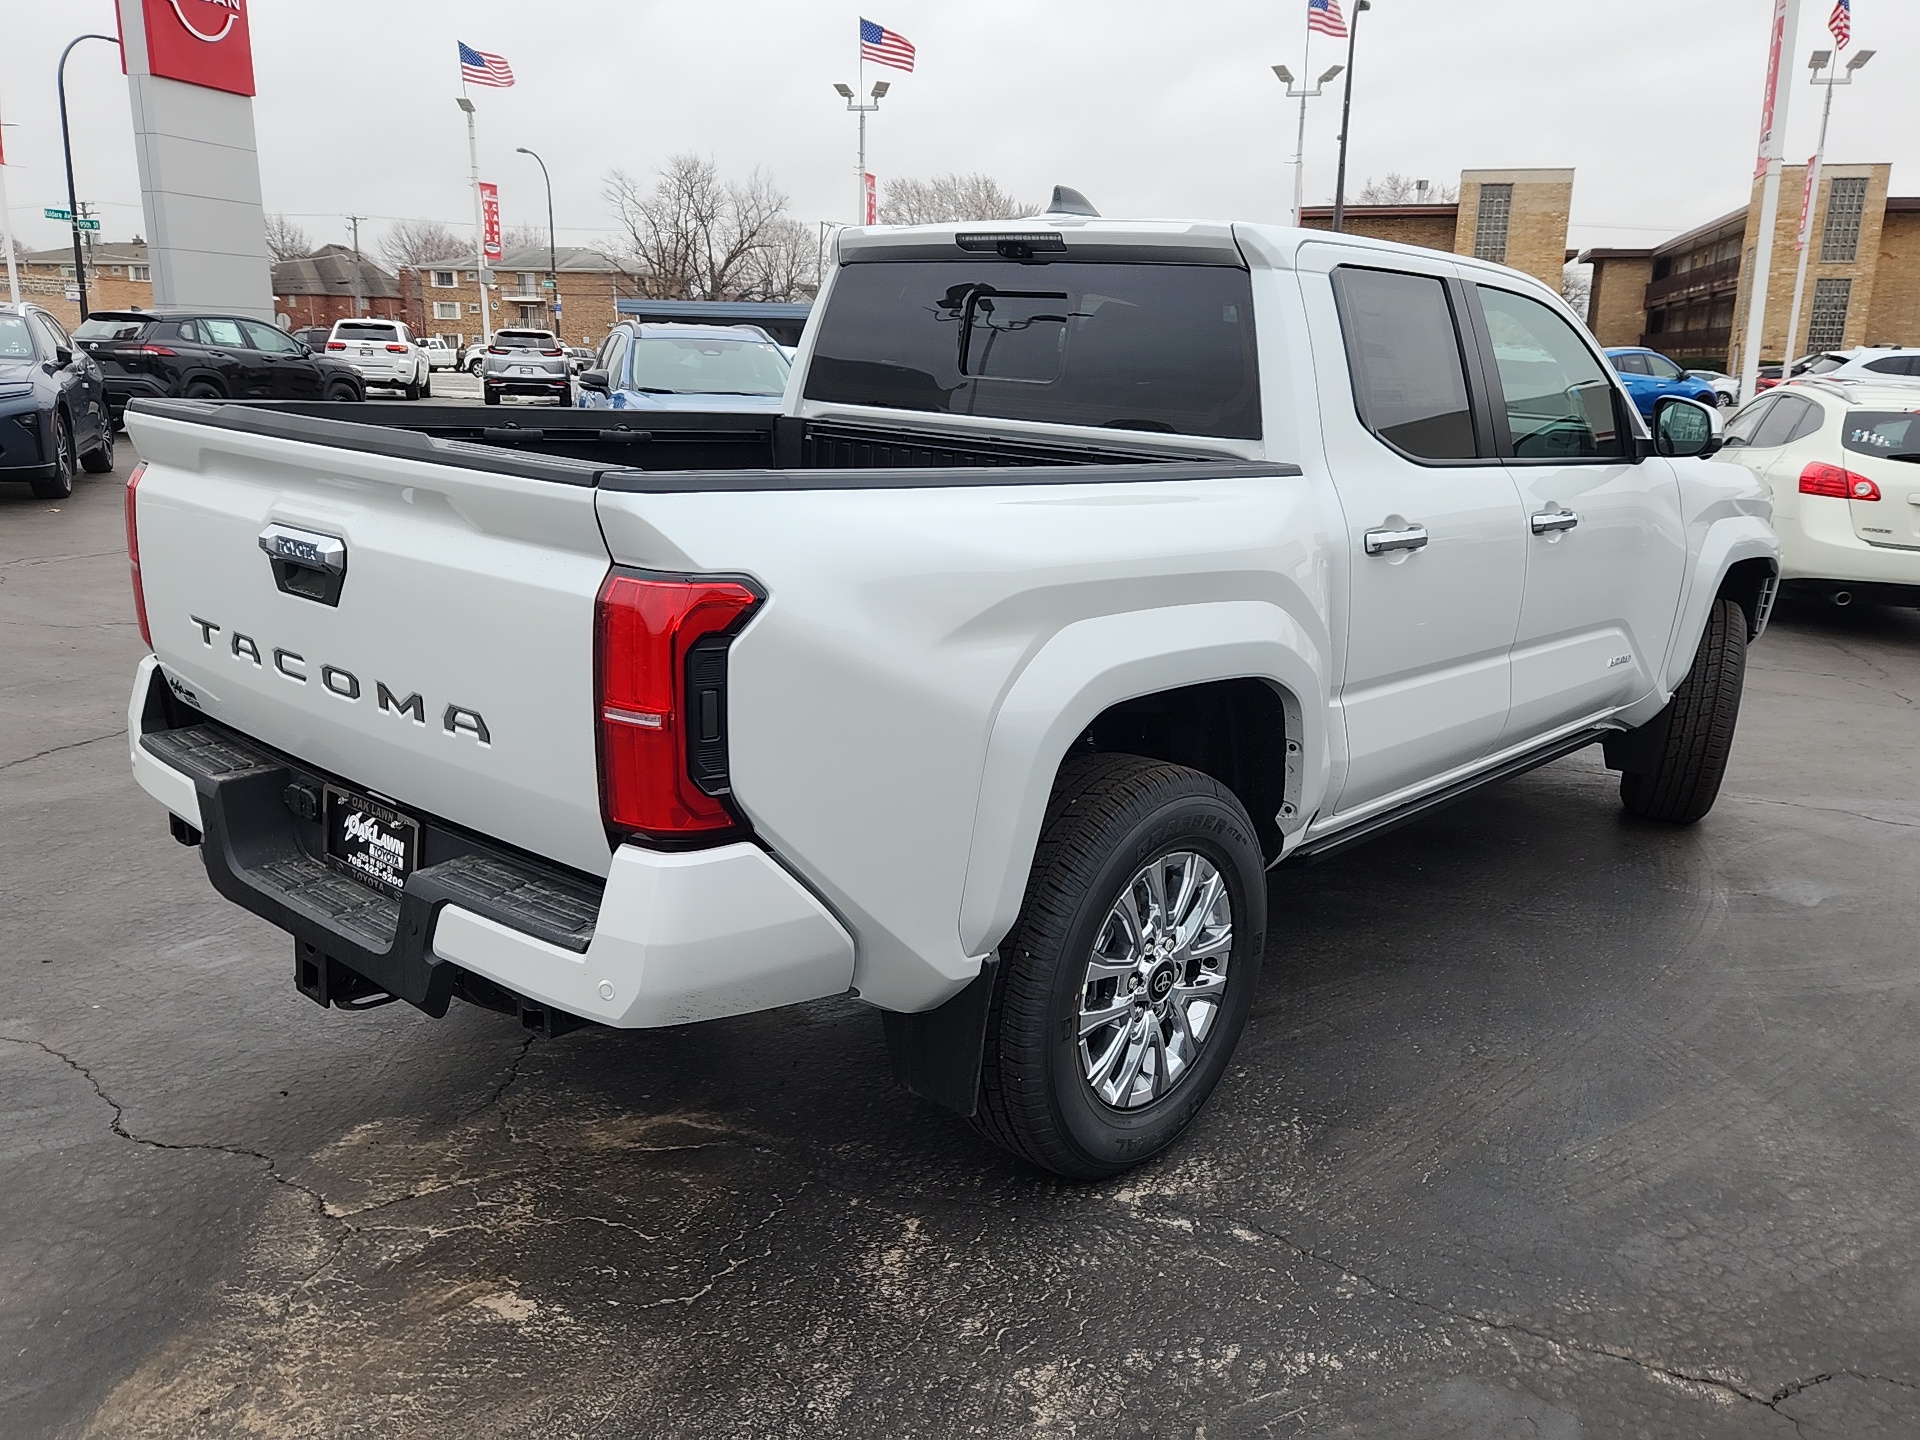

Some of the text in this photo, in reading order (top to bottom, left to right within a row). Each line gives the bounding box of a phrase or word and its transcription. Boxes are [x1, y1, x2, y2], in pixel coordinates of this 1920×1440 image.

[277, 538, 317, 561] TOYOTA
[189, 614, 492, 748] TACOMA
[352, 797, 394, 822] OAK LAWN
[372, 845, 403, 869] TOYOTA
[347, 854, 404, 888] 708-423-5200
[352, 869, 385, 891] TOYOTA
